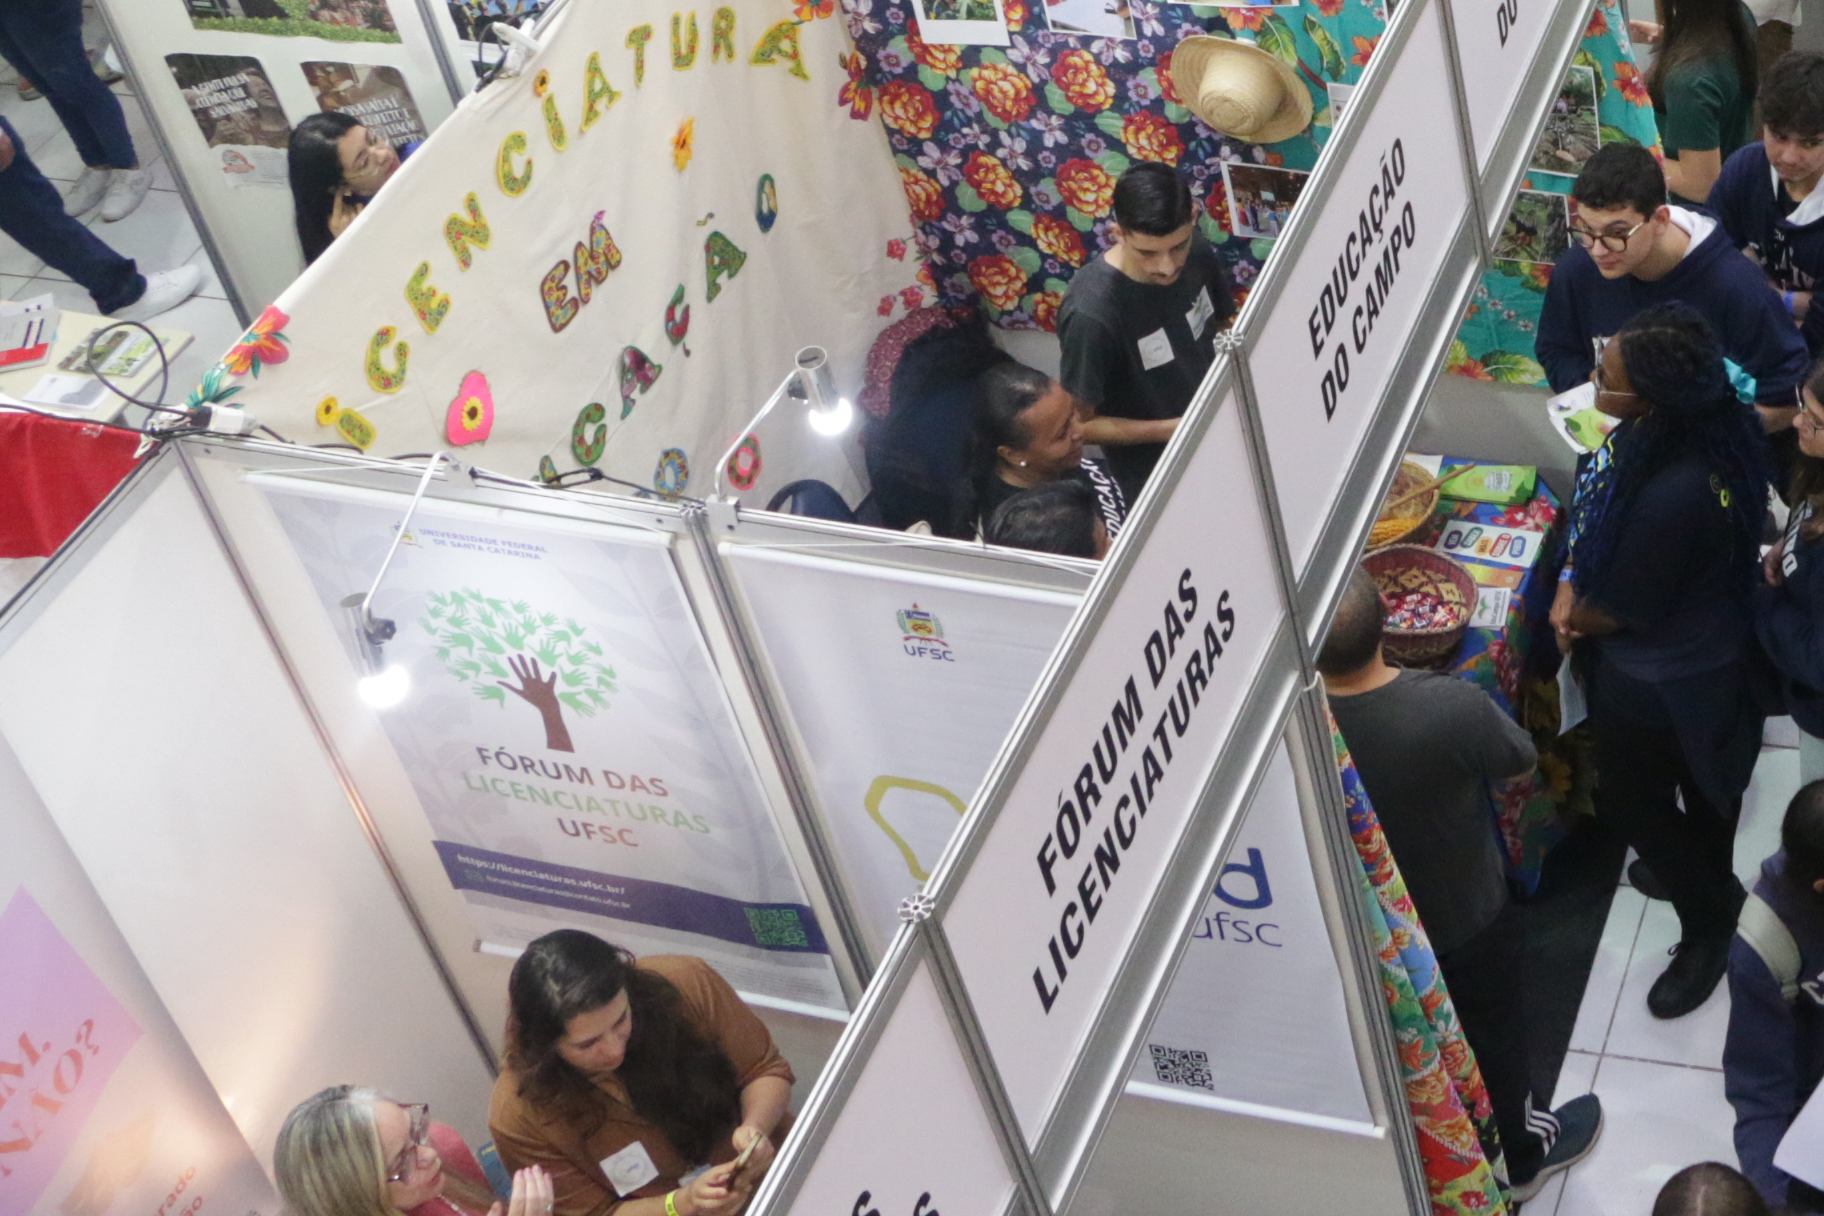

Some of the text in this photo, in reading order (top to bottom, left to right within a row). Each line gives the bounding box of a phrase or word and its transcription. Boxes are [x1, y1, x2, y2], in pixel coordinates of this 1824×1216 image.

[540, 211, 622, 334] EM
[1307, 137, 1407, 361] EDUCAÇÃO
[1319, 199, 1417, 424] DO CAMPO
[419, 527, 549, 554] UNIVERSIDADE FEDERAL
[434, 538, 542, 561] DE SANTA CATARINA
[1478, 538, 1490, 553] MAIS
[902, 643, 955, 663] UFSC
[1035, 567, 1199, 898] FÓRUM DAS
[476, 745, 670, 798] FÓRUM DAS
[461, 771, 712, 835] LICENCIATURAS
[1031, 589, 1236, 1016] LICENCIATURAS
[556, 816, 639, 848] UFSC
[456, 852, 626, 896] https://licenciaturas.ufsc.br/
[1193, 910, 1284, 950] ufsc
